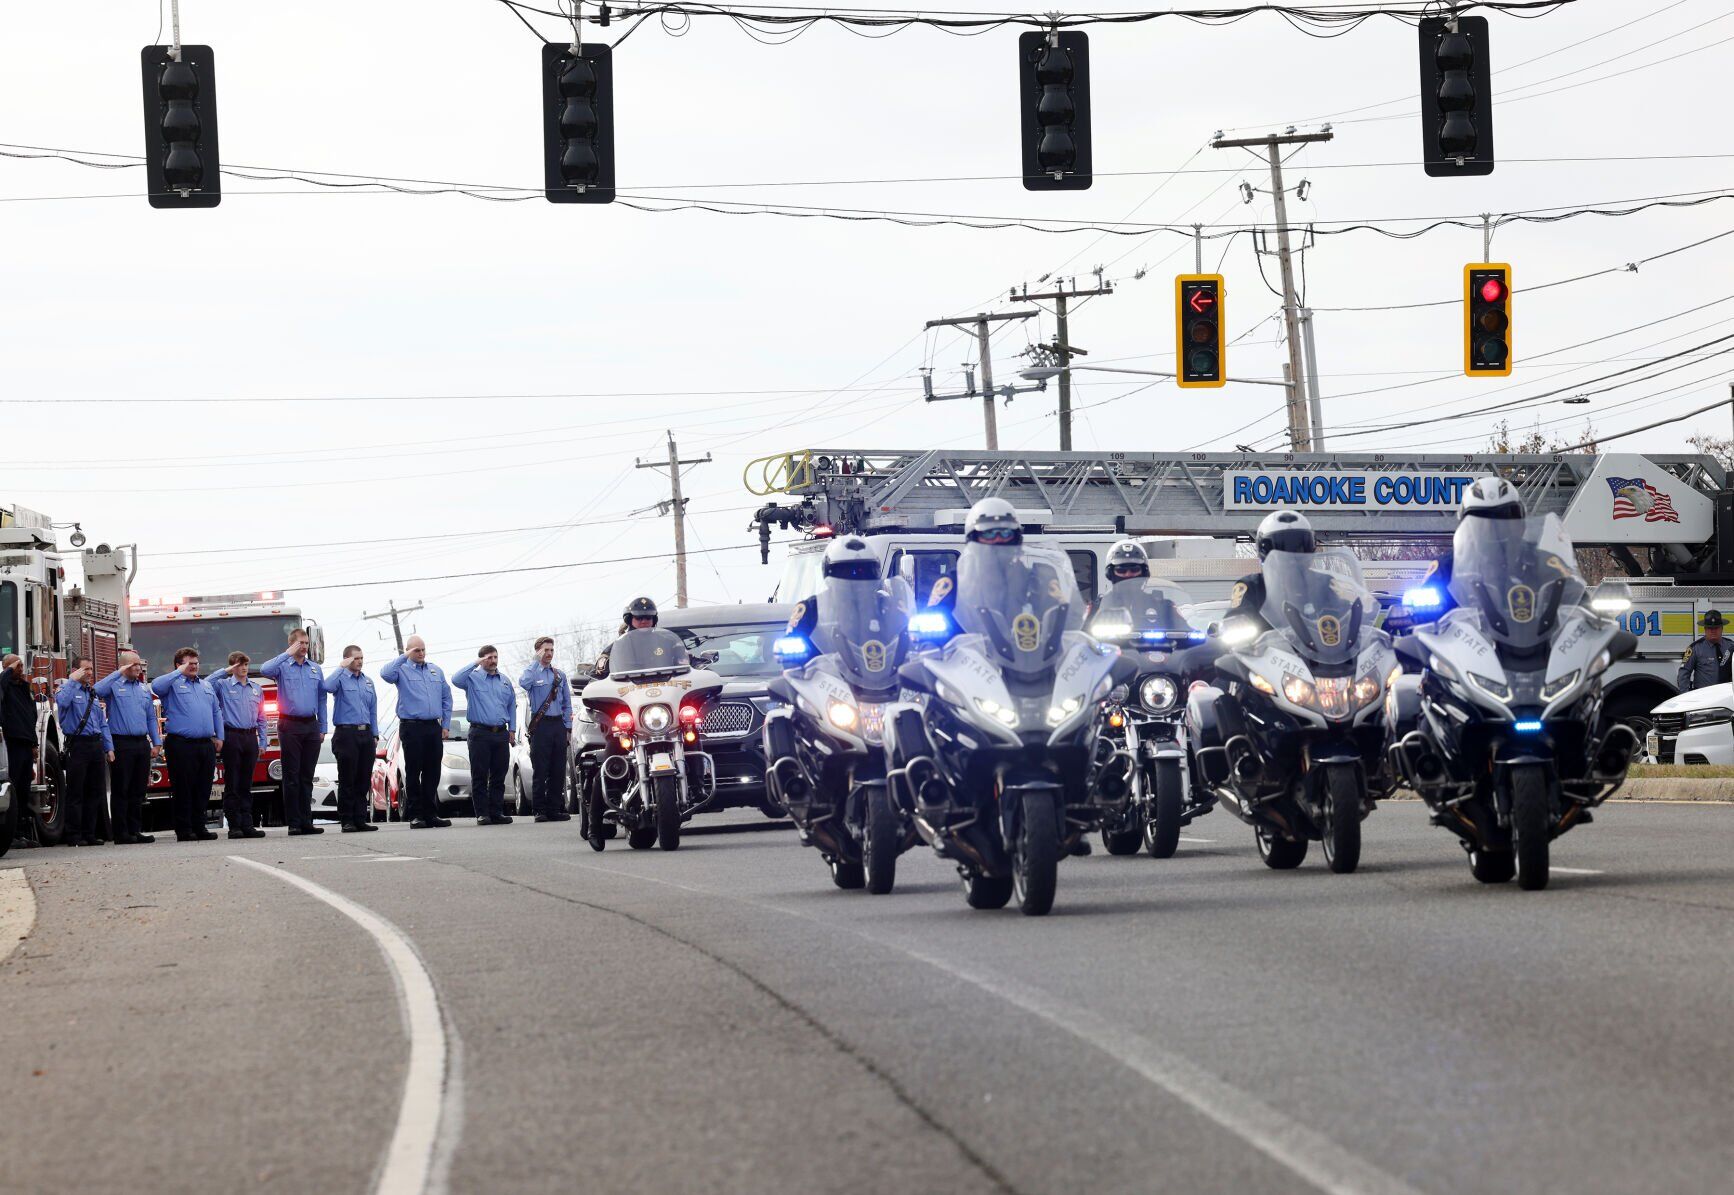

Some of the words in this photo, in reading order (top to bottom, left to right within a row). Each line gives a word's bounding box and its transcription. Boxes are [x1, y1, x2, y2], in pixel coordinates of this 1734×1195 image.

[1110, 452, 1125, 460] 109
[1191, 453, 1207, 461] 100
[1284, 454, 1294, 462] 90
[1374, 454, 1385, 462] 80
[1463, 454, 1474, 463] 70
[1552, 455, 1563, 463] 60
[1233, 475, 1366, 505] ROANOKE
[1373, 475, 1479, 505] COUNT
[1616, 610, 1662, 636] 101
[1453, 628, 1489, 657] STATE
[1557, 624, 1587, 655] POLICE
[960, 655, 998, 685] STATE
[1060, 653, 1089, 682] POLICE
[1270, 656, 1305, 677] STATE
[818, 680, 851, 701] STATE
